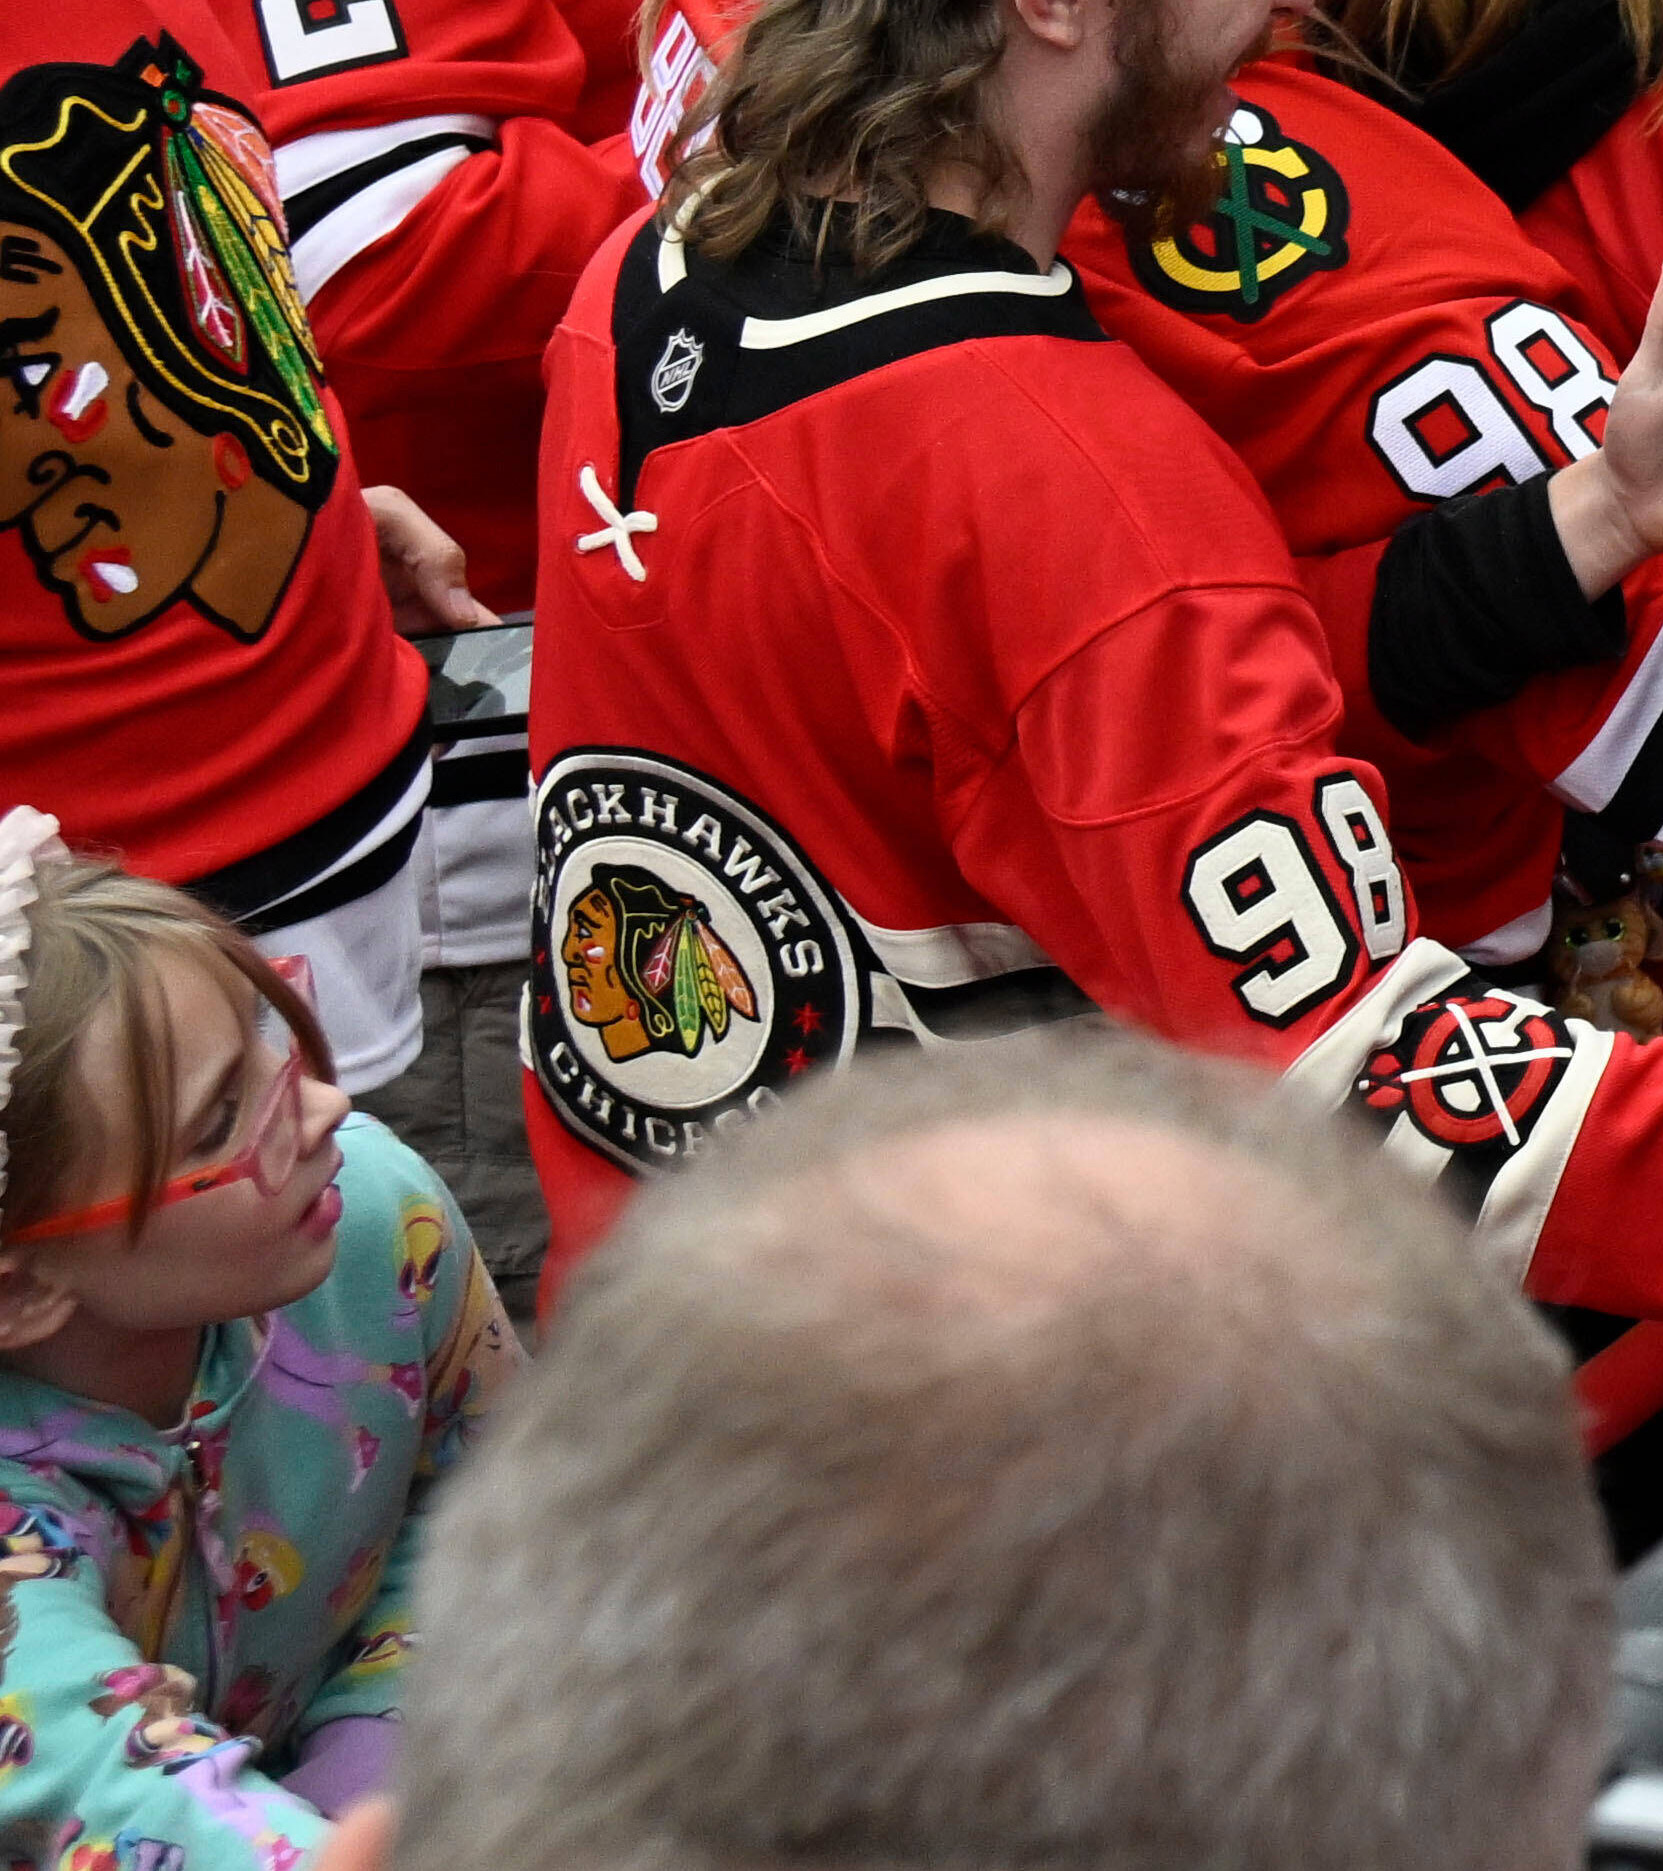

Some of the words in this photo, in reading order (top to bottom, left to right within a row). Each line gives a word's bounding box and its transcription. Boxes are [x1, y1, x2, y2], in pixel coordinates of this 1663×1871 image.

[658, 359, 698, 391] NHL
[1366, 293, 1618, 505] 98
[540, 781, 826, 980] ACKHAWKS
[1180, 770, 1414, 1030] 98
